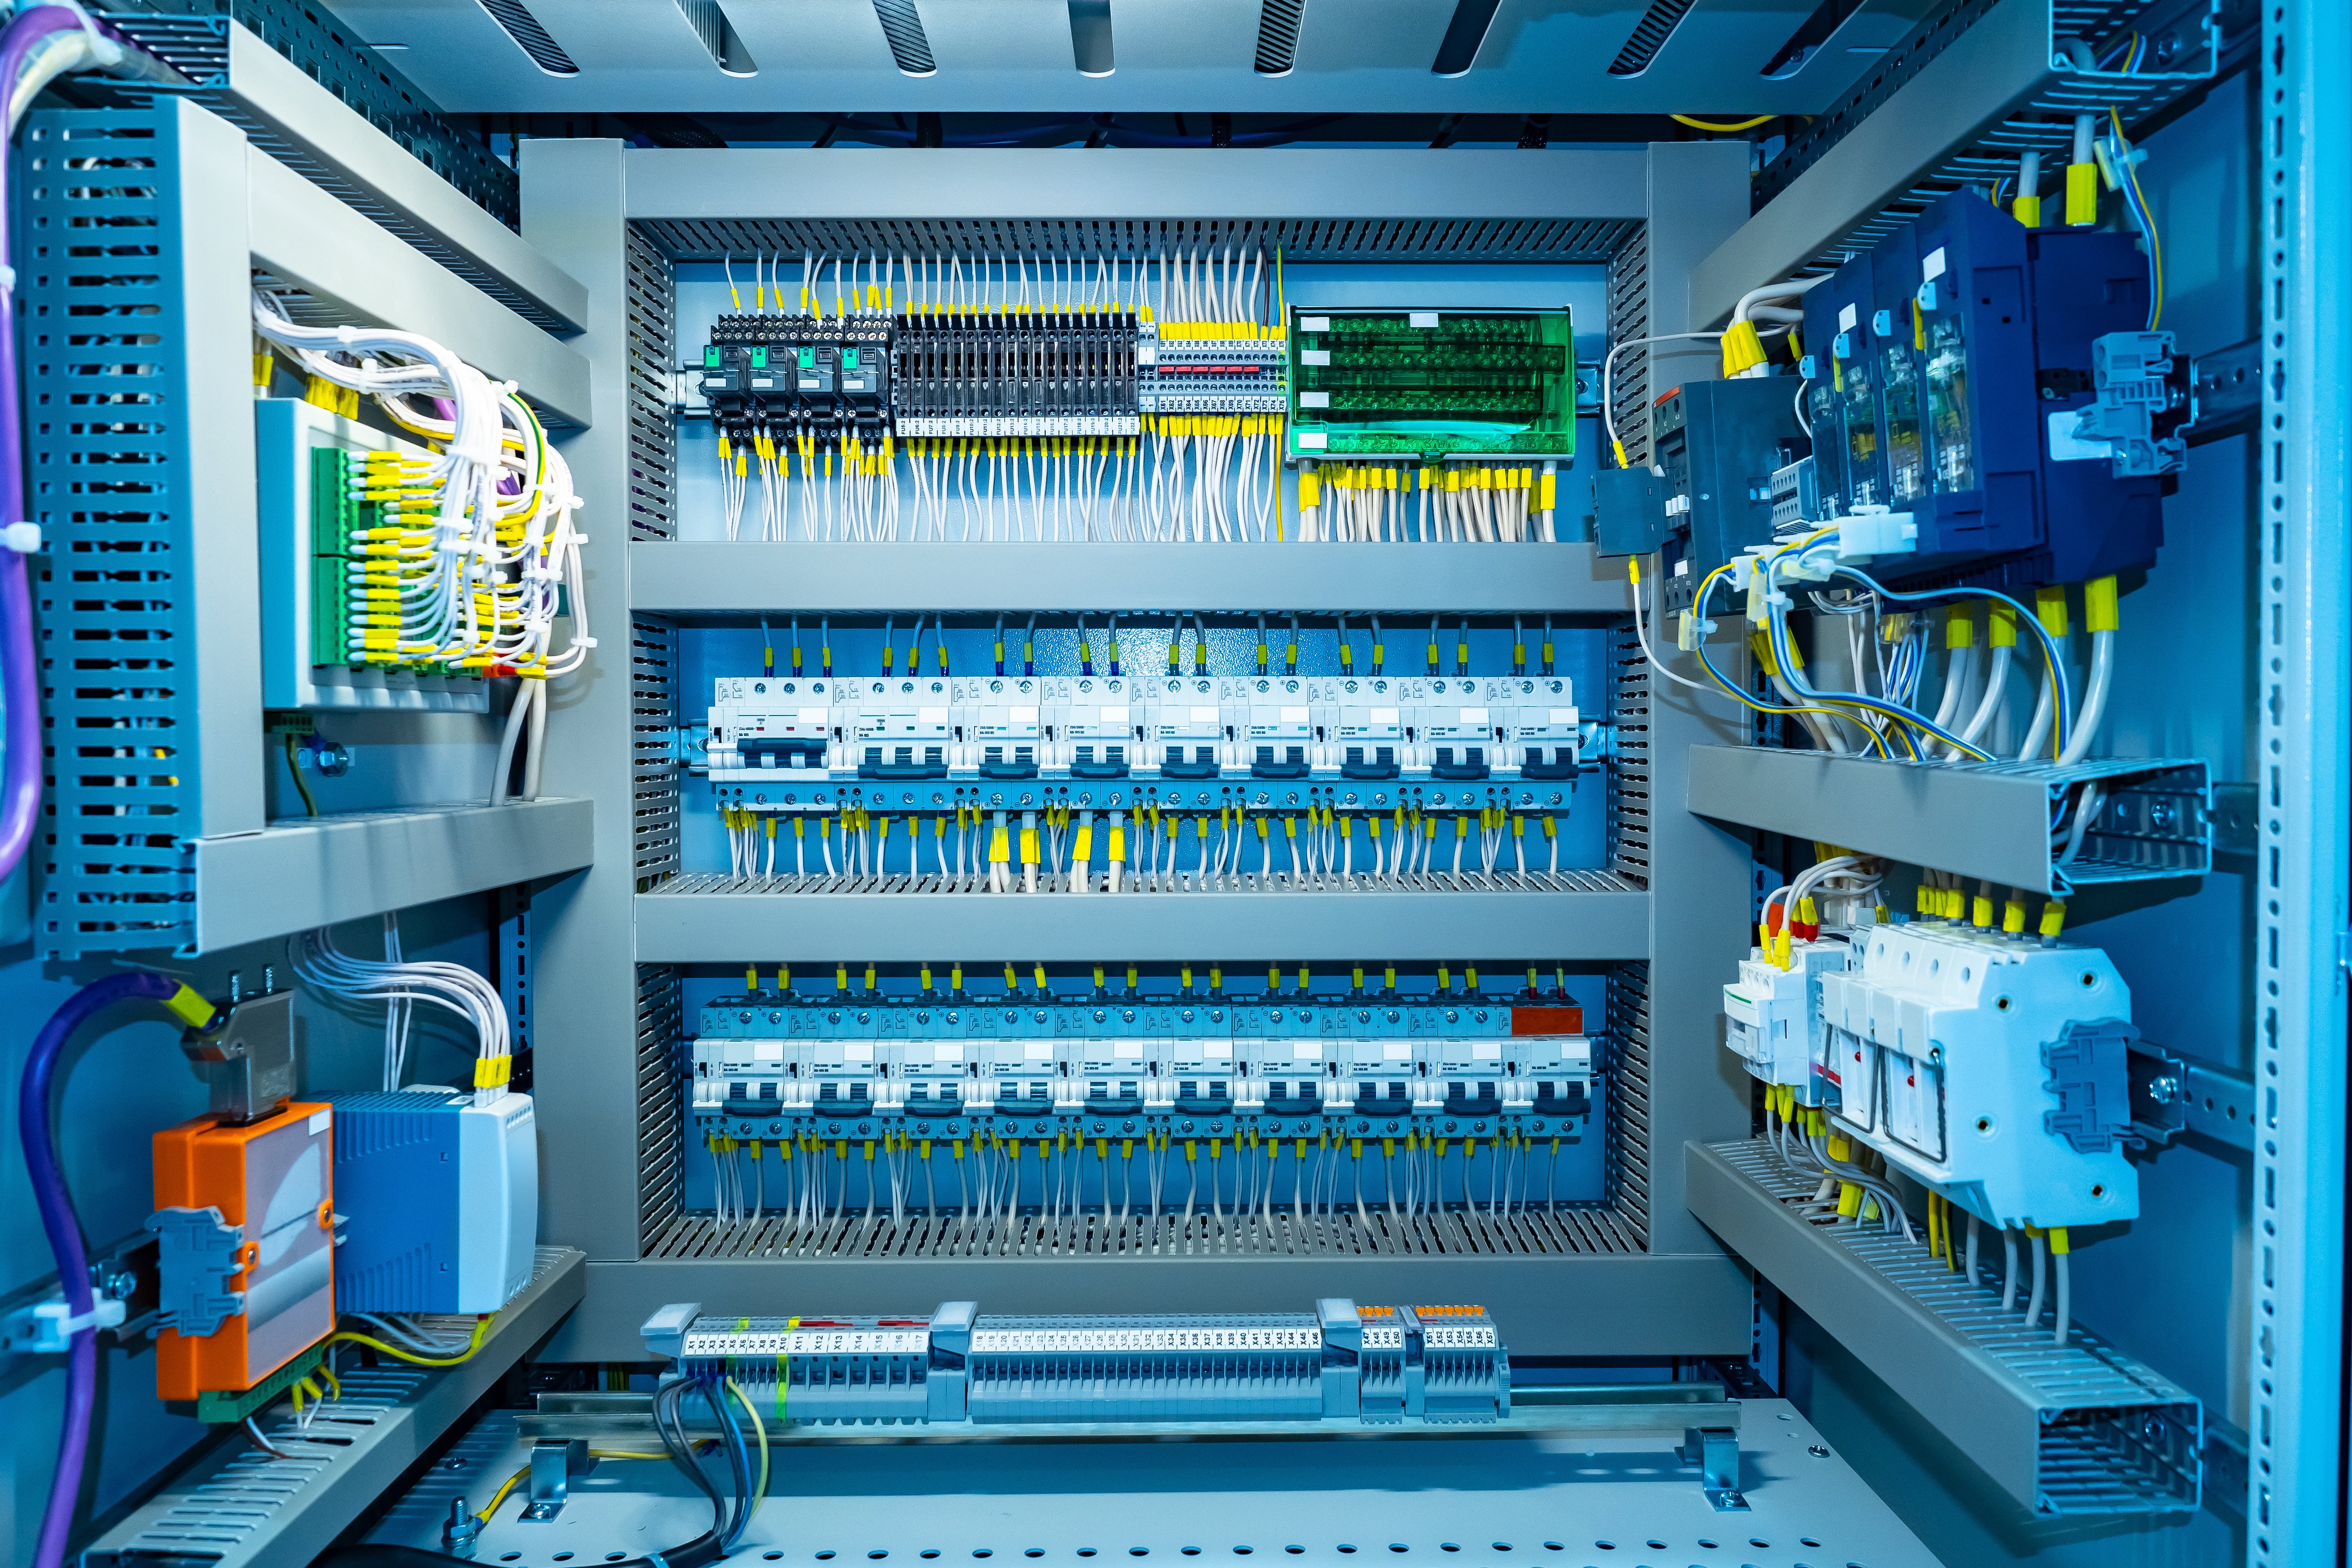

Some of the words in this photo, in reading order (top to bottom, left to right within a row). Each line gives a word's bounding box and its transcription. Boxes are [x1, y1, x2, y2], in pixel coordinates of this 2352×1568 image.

[814, 1335, 823, 1350] X12
[833, 1335, 843, 1350] X13
[854, 1335, 863, 1350] X14
[874, 1335, 883, 1350] X15
[1426, 1332, 1434, 1344] X51
[687, 1341, 696, 1349] X1
[698, 1340, 706, 1349] X2
[708, 1340, 716, 1349] X3
[718, 1339, 726, 1349] X4
[729, 1339, 736, 1348] X5
[739, 1339, 746, 1348] X6
[748, 1340, 755, 1349] X7
[759, 1340, 766, 1349] X8
[769, 1339, 777, 1348] X9
[779, 1337, 787, 1350] X10
[794, 1336, 804, 1351] X11
